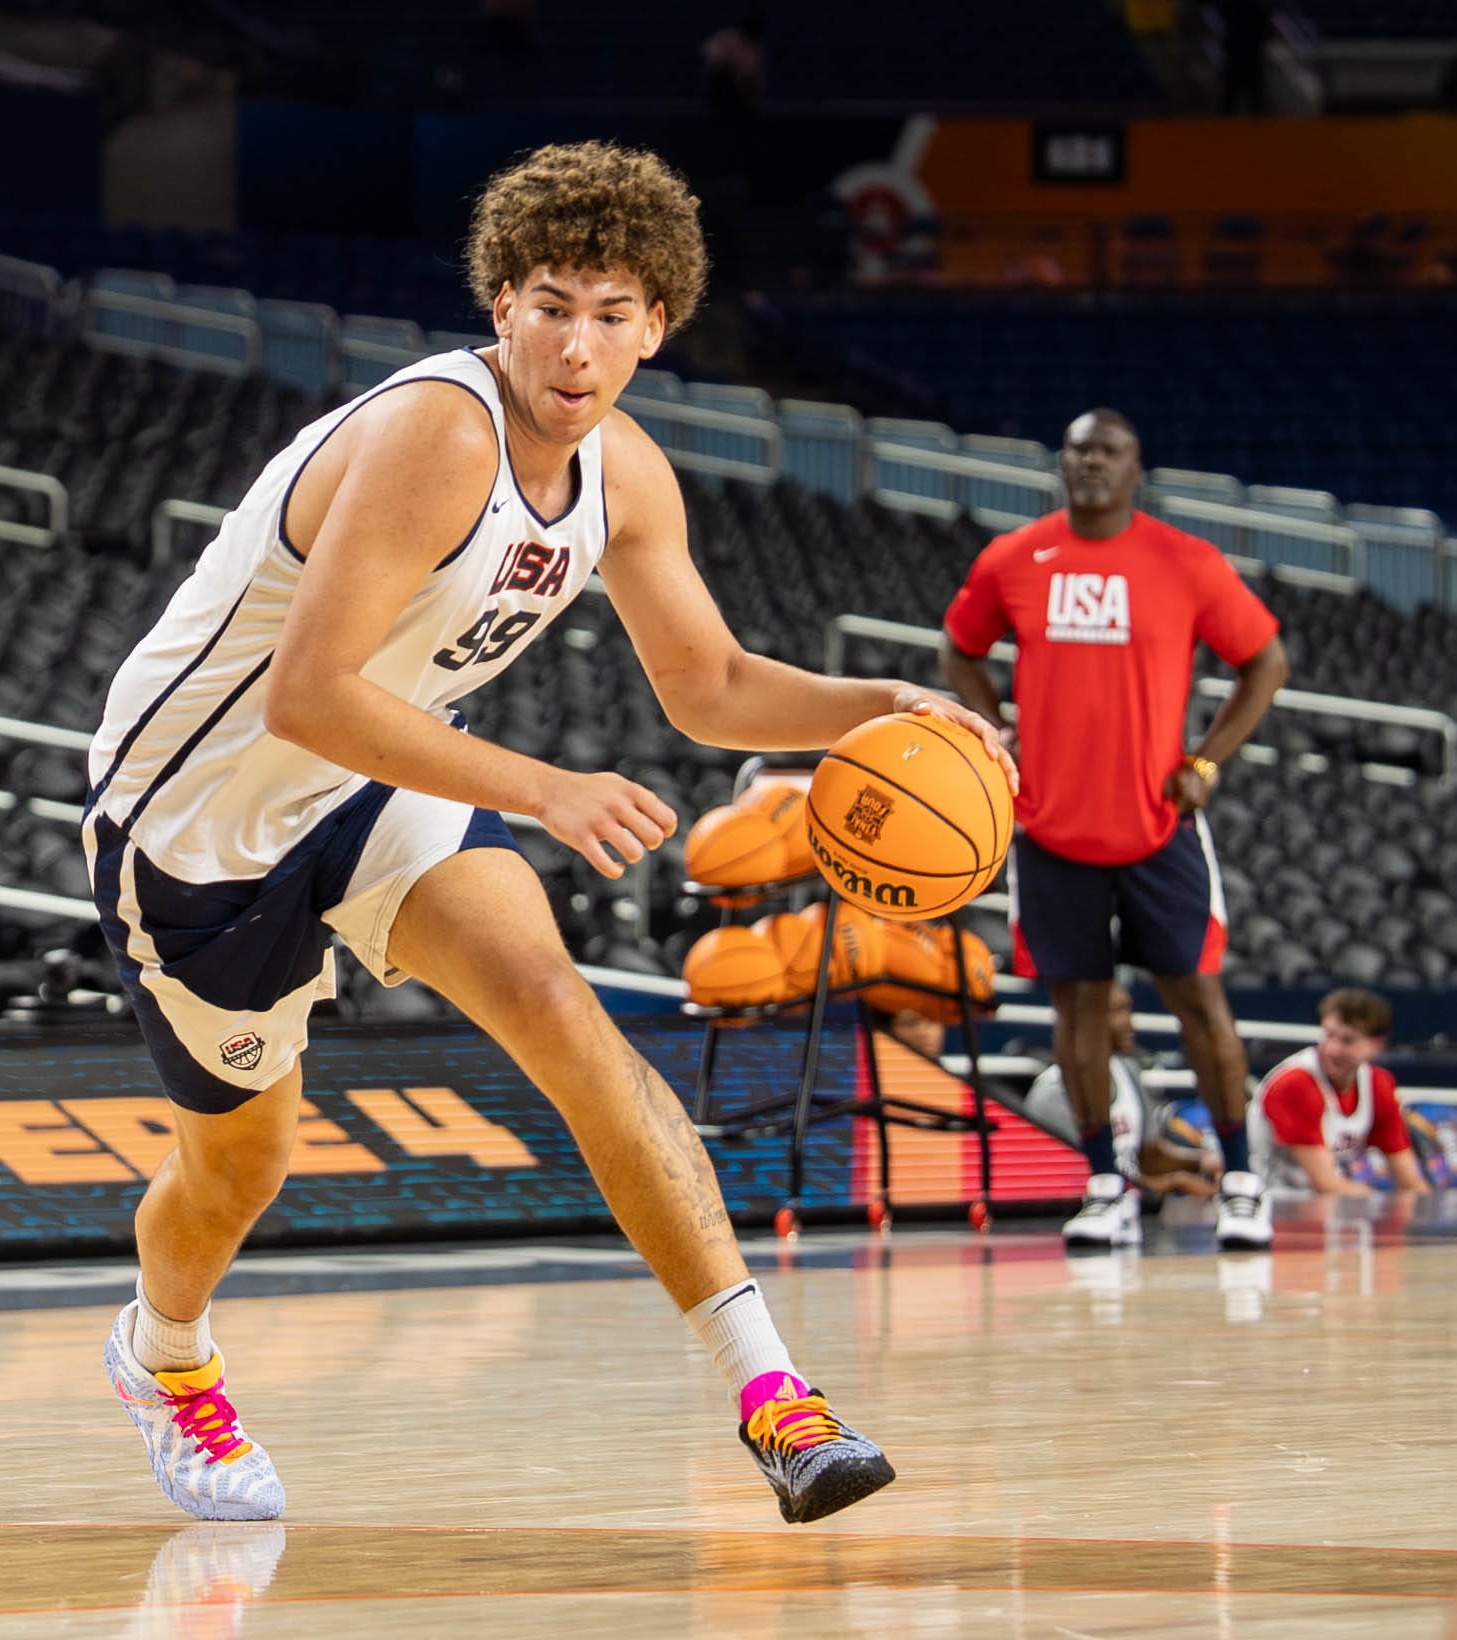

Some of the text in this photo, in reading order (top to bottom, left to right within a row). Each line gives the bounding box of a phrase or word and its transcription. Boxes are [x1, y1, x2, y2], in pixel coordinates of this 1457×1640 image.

[488, 541, 570, 597] USA
[1048, 573, 1130, 627] USA
[433, 608, 541, 671] 99
[225, 1037, 254, 1055] USA
[344, 1087, 539, 1168] 4
